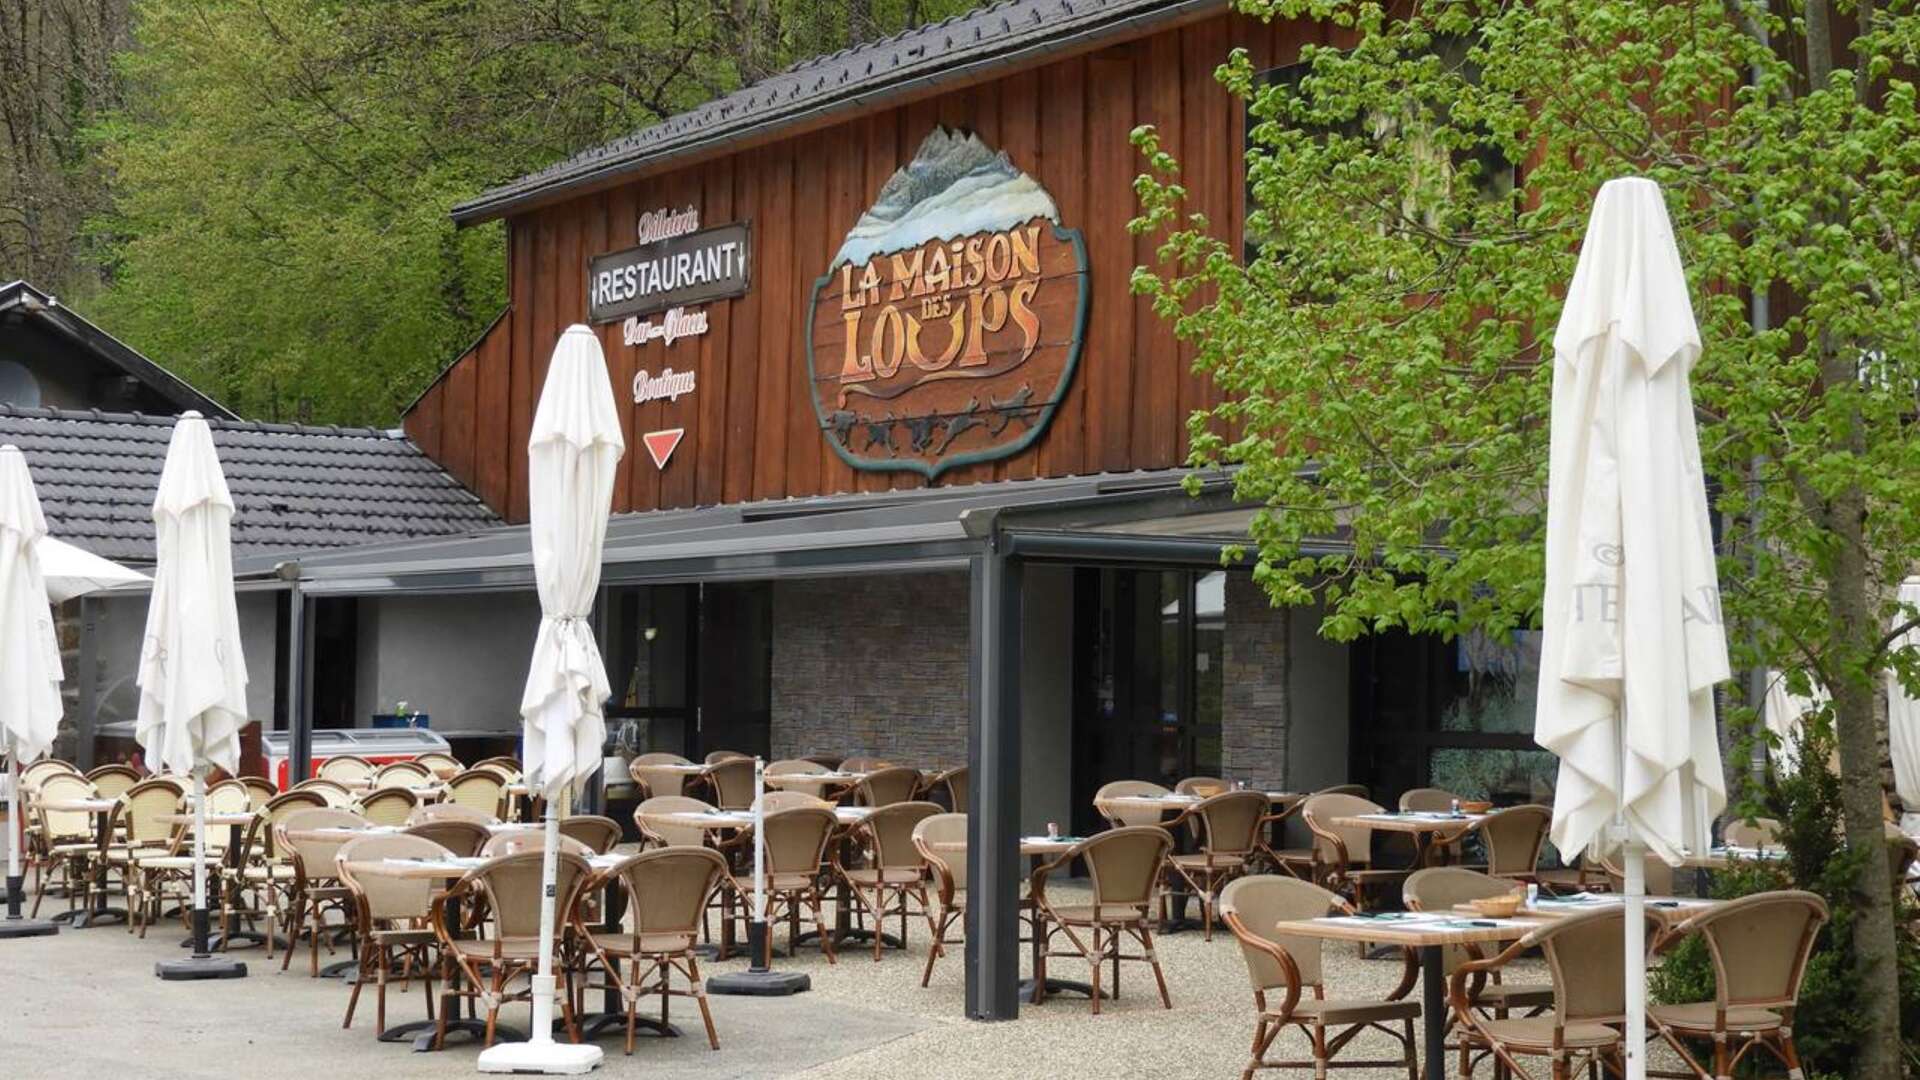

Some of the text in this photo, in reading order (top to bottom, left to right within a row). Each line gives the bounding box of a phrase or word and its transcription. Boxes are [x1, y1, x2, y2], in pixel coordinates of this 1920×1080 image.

[598, 242, 737, 305] RESTAURANT
[841, 263, 882, 310] LA
[840, 276, 1041, 384] LOUPS
[921, 295, 952, 321] DES
[633, 367, 696, 404] Boutique
